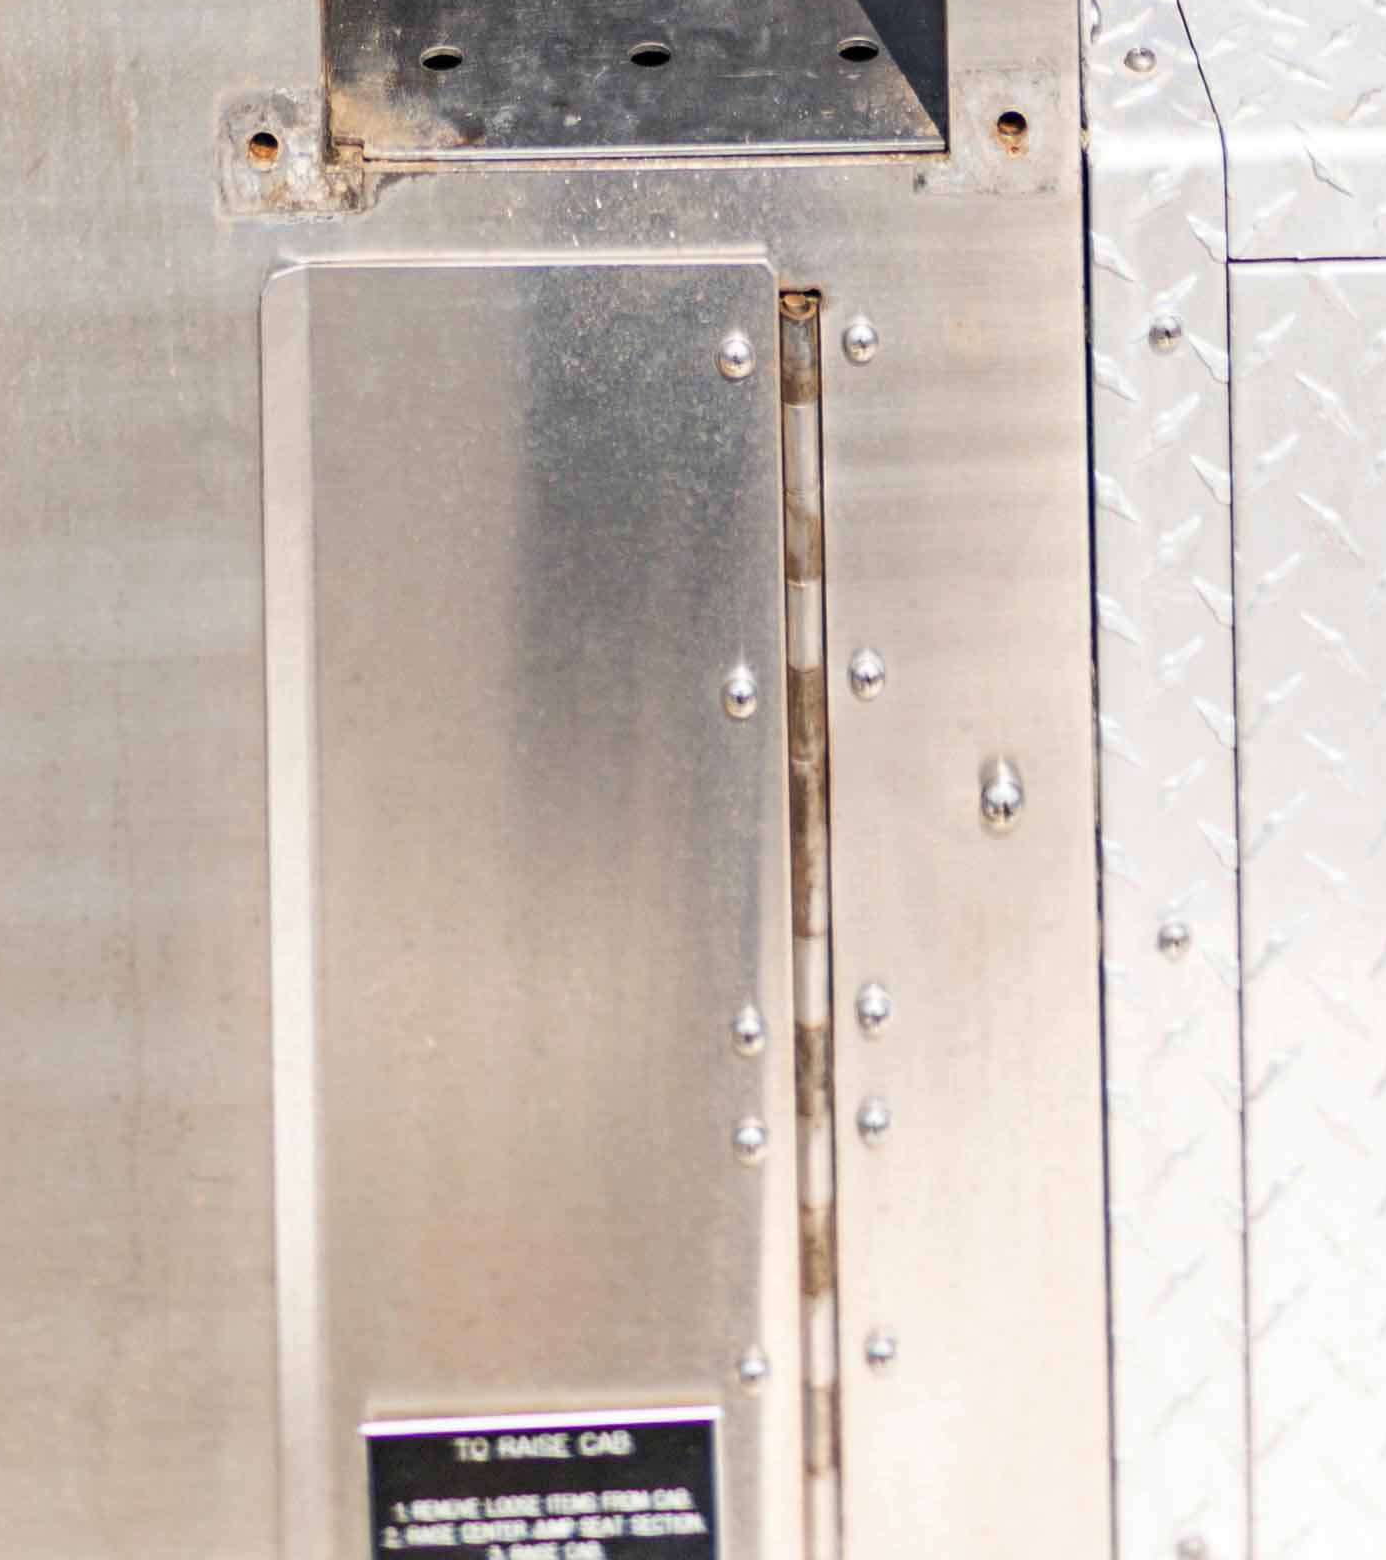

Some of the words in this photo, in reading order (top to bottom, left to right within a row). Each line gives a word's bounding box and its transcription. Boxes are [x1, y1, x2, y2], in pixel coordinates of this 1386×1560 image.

[455, 1436, 491, 1462] TO
[496, 1433, 574, 1459] RAISE
[579, 1430, 635, 1456] CAB
